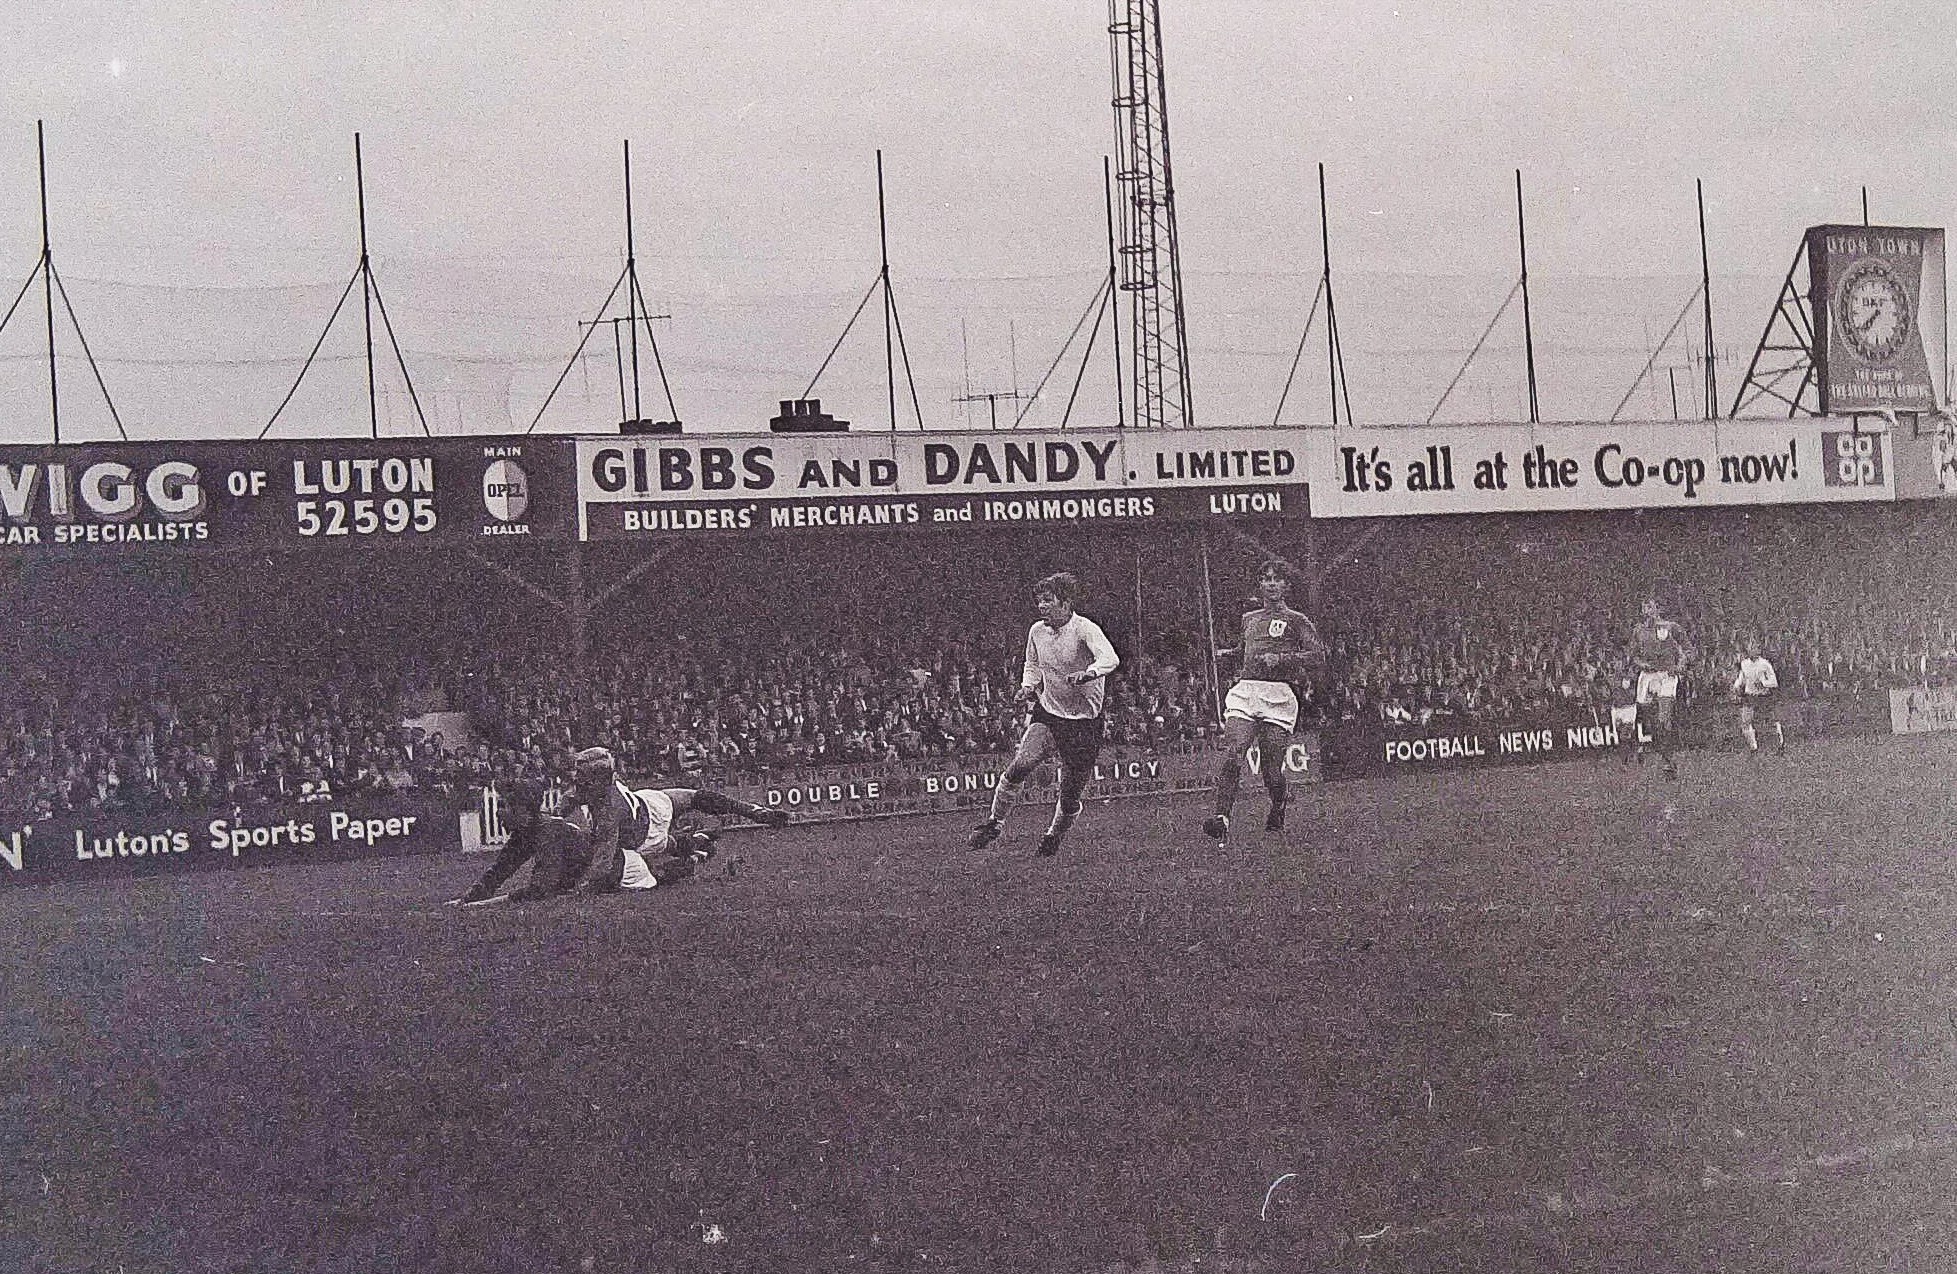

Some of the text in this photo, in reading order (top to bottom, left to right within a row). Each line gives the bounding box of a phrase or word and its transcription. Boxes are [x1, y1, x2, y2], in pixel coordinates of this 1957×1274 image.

[483, 446, 522, 457] MAIN
[1340, 441, 1799, 497] It's all at the Co-op now!
[227, 470, 267, 497] OF
[293, 458, 435, 494] LUTON
[591, 447, 776, 492] GIBBS
[797, 458, 898, 489] AND
[1156, 449, 1295, 480] LIMITED
[487, 483, 525, 498] OPEL
[297, 499, 437, 536] 52595
[624, 492, 1282, 531] BUILDERS' MERCHANTS and IRONMONGERS LUTON
[54, 521, 209, 543] SPECIALISTS
[482, 524, 531, 536] DEALER
[1385, 735, 1485, 763] FOOTBALL
[1499, 729, 1553, 754] NEWS
[768, 782, 880, 806] DOUBLE
[926, 773, 1000, 793] BONU
[75, 827, 190, 861] Luton's
[209, 818, 316, 855] Sports
[330, 811, 416, 845] Paper
